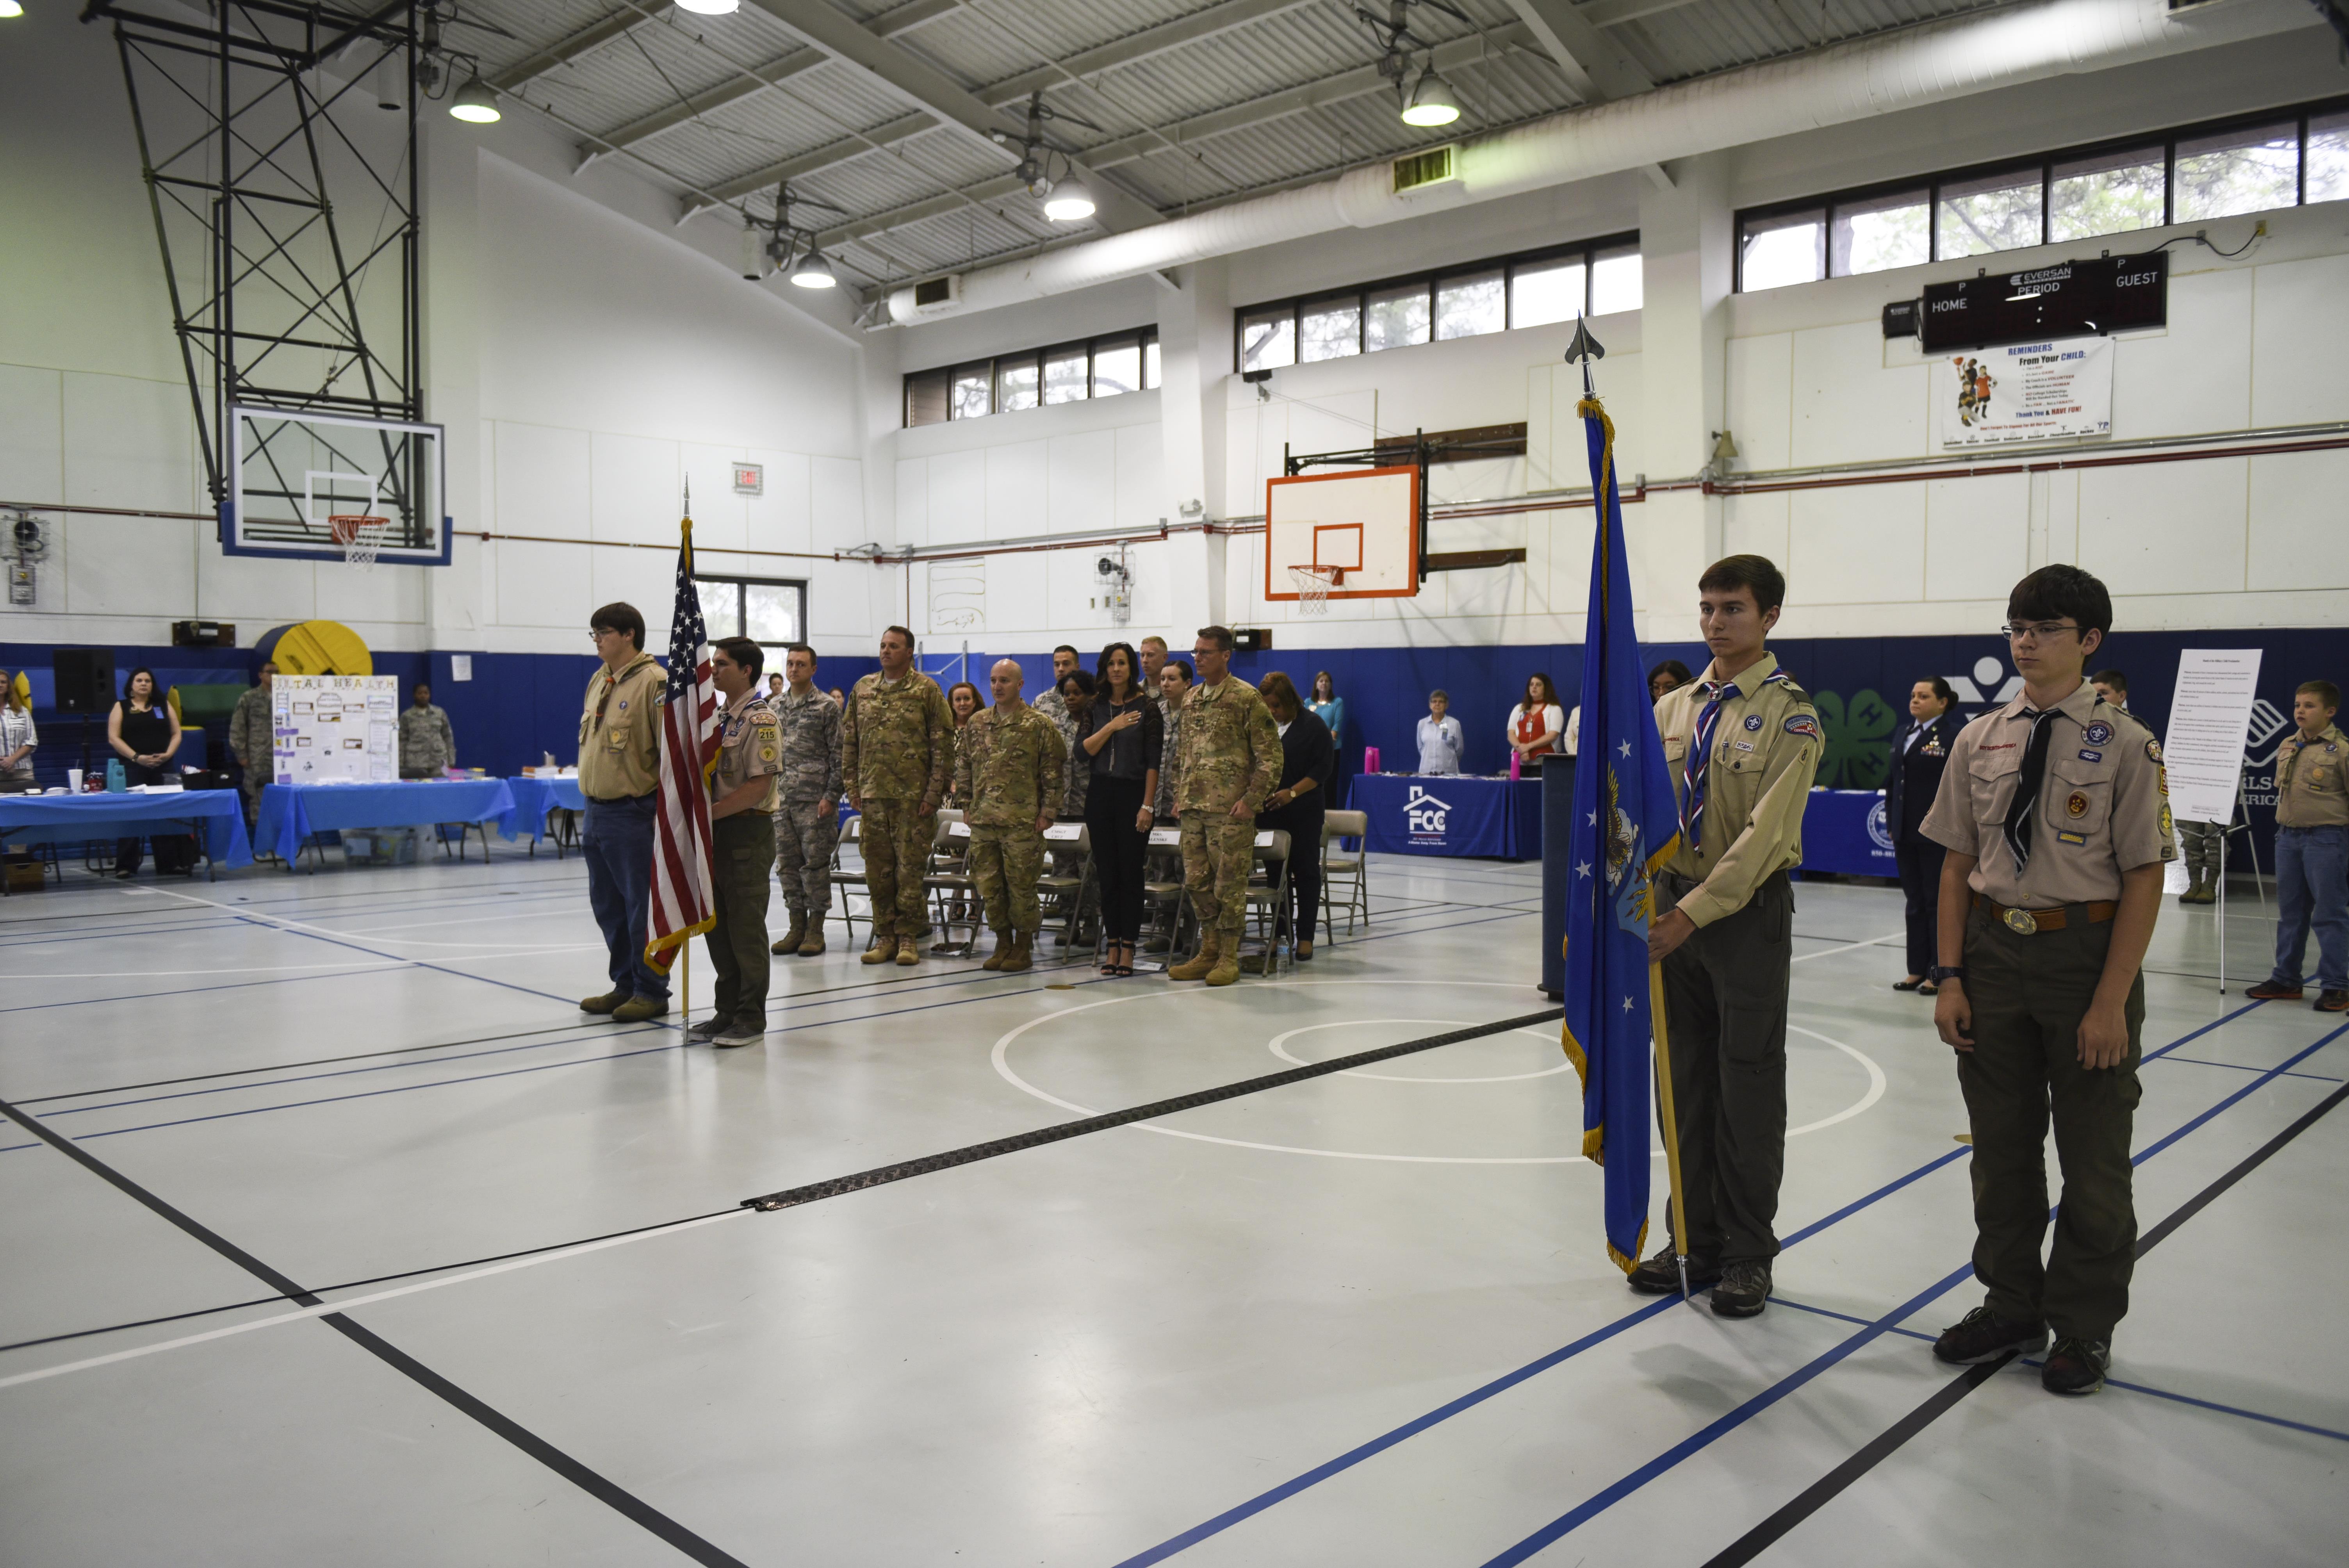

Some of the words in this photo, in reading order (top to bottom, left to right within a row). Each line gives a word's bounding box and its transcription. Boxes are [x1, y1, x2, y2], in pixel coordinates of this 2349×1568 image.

[2118, 259, 2126, 268] P
[2024, 267, 2071, 281] EVERSAN
[2116, 272, 2158, 287] GUEST
[1959, 283, 1966, 292] P
[2018, 282, 2060, 296] PERIOD
[1933, 298, 1967, 312] HOME
[2008, 344, 2053, 356] REMINDERS
[2019, 357, 2039, 366] From
[2041, 355, 2059, 363] Your
[2061, 351, 2086, 361] CHILD:
[2051, 407, 2066, 415] HAVE
[334, 677, 394, 690] HEALTH
[1801, 749, 1807, 761] 8
[1409, 810, 1445, 831] FCC
